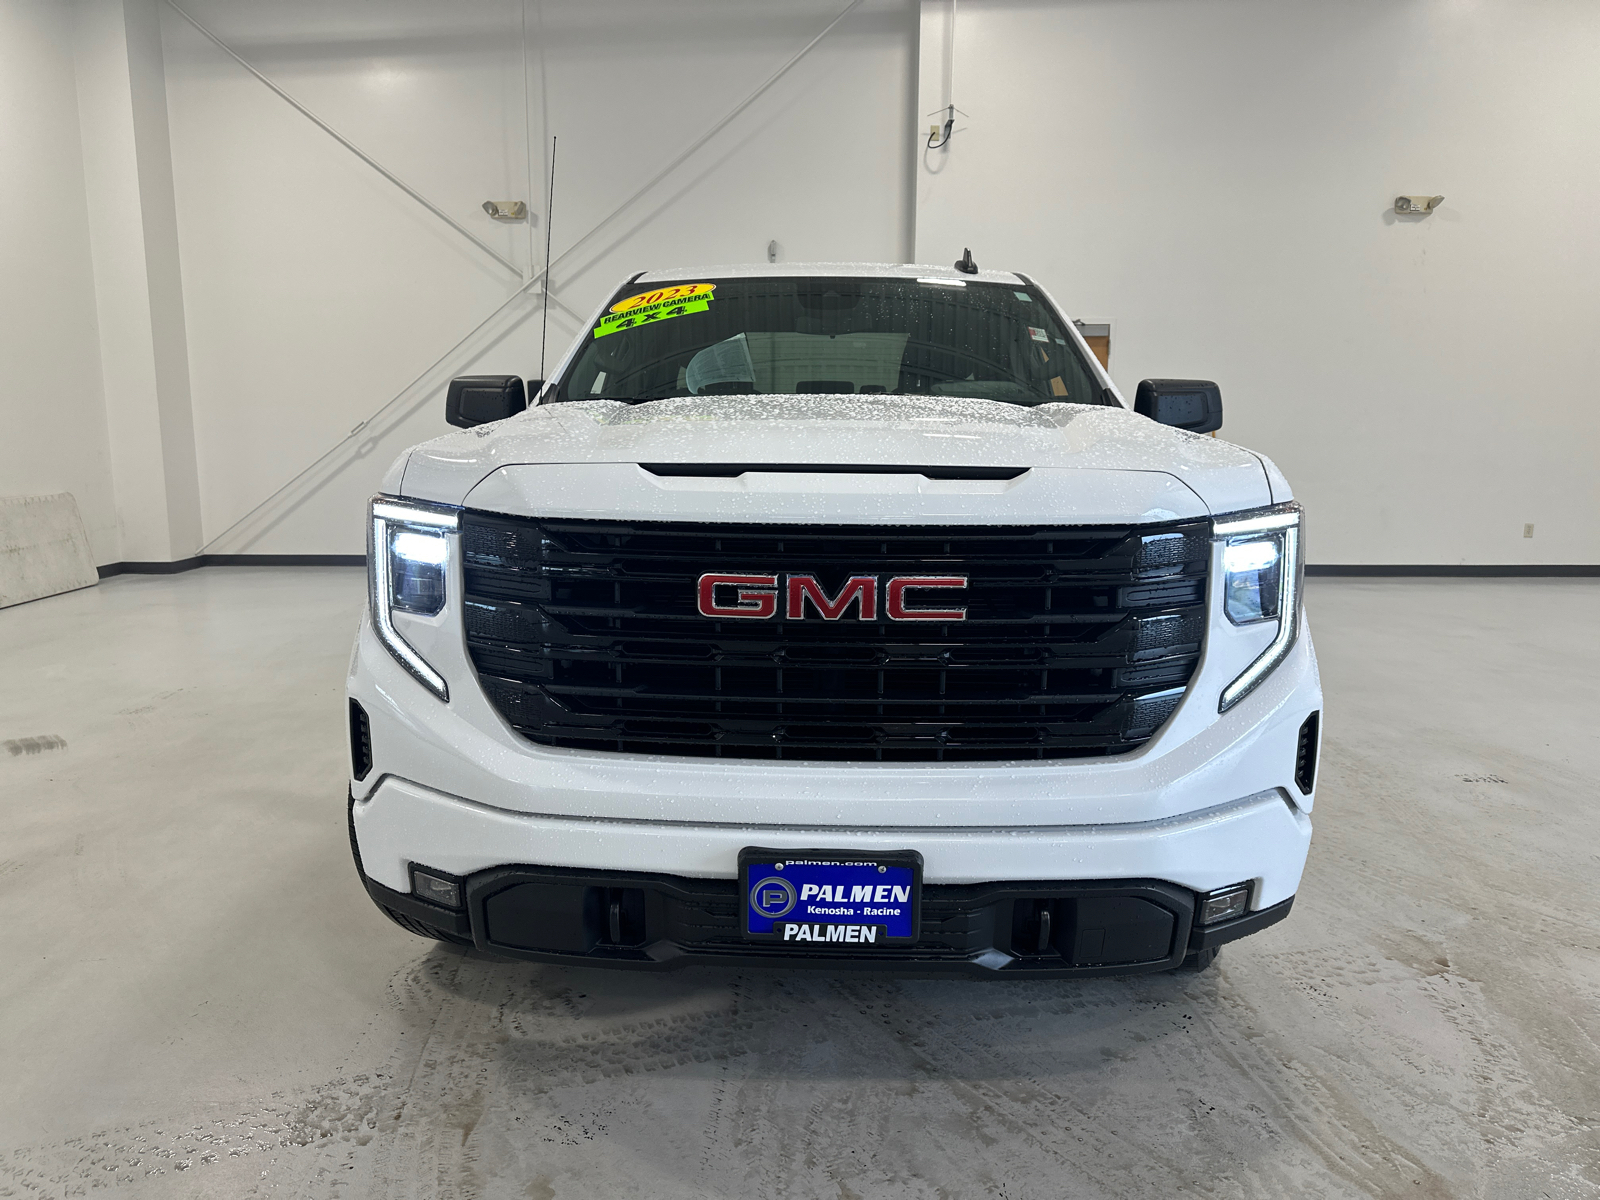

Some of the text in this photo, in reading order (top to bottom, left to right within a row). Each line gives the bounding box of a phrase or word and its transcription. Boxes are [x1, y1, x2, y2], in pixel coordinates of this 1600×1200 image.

[628, 285, 698, 309] 2023
[603, 293, 711, 324] REARVIEW CAMERA
[697, 573, 968, 621] GMC
[800, 883, 911, 903] PALMEN
[807, 905, 854, 916] Kenosha
[863, 906, 901, 916] Racine
[783, 923, 877, 943] PALMEN
